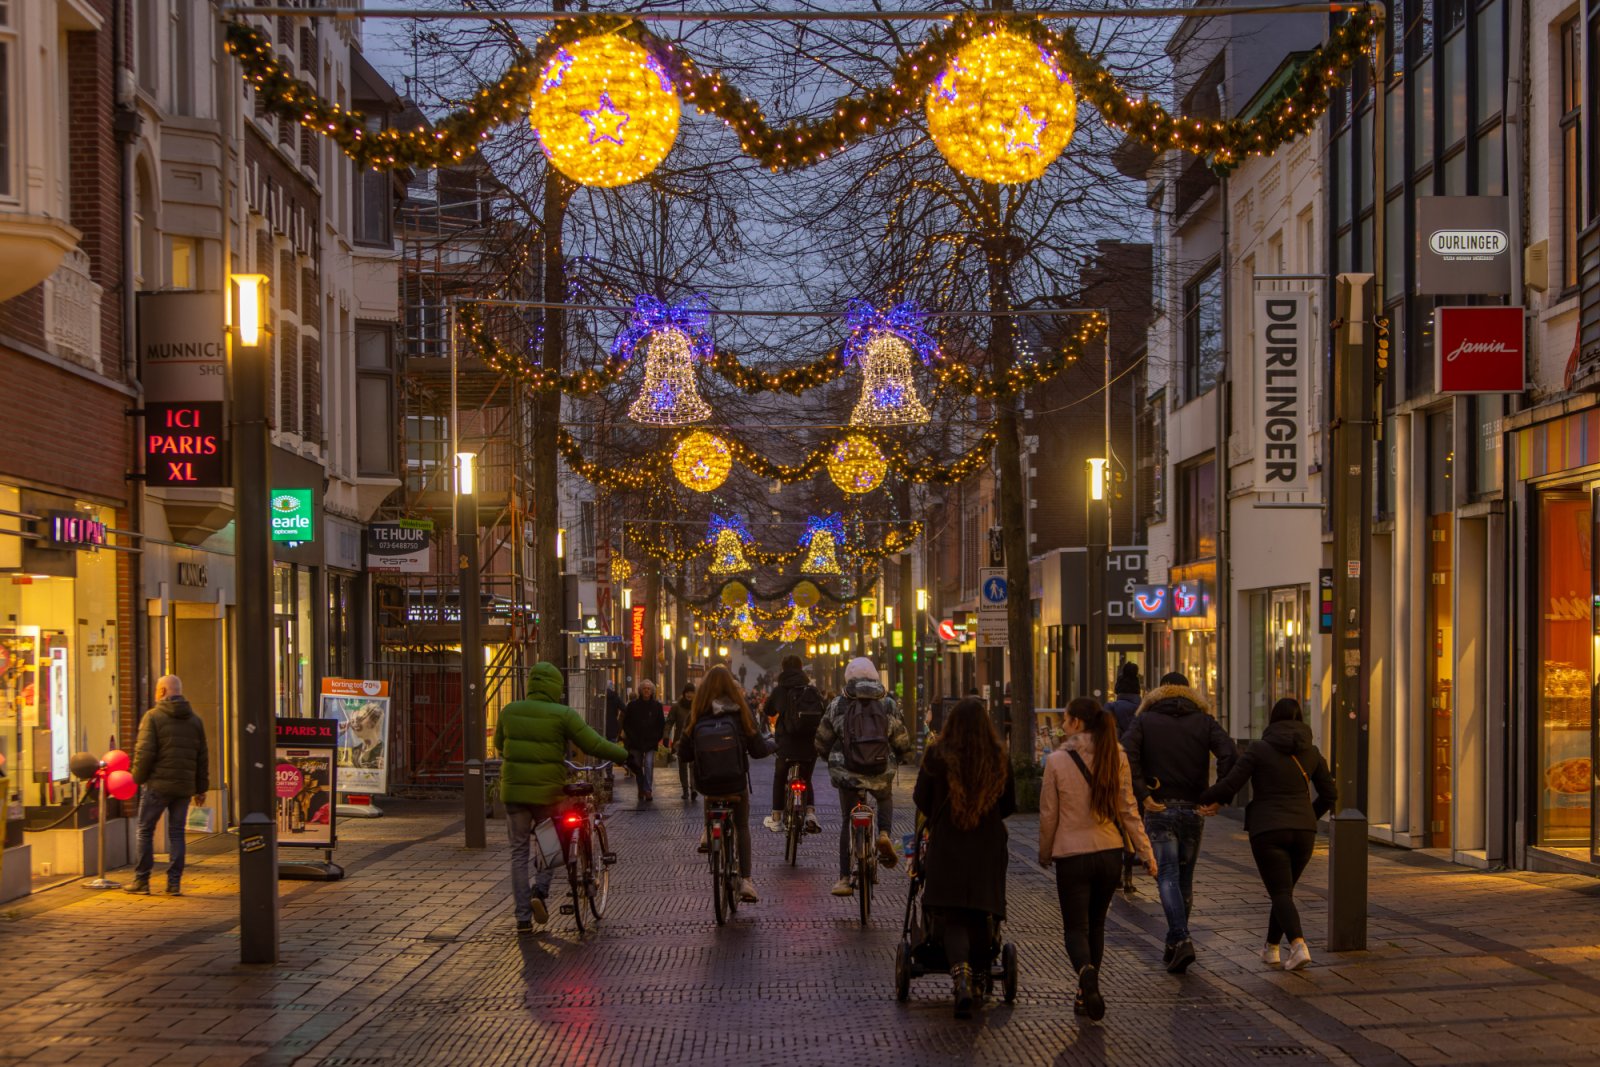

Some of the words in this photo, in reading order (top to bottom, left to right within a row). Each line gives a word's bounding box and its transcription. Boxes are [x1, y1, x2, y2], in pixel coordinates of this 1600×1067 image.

[1438, 235, 1499, 250] DURLINGER
[146, 342, 224, 359] MUNNICH
[1446, 337, 1518, 362] jamin
[199, 364, 224, 376] SHO
[1265, 299, 1297, 484] DURLINGER
[166, 409, 200, 428] ICI
[149, 435, 217, 455] PARIS
[167, 462, 198, 481] XL
[271, 514, 310, 528] earle
[373, 528, 388, 540] TE
[390, 528, 424, 541] HUUR
[331, 680, 353, 690] korting
[285, 725, 317, 736] PARIS
[319, 726, 332, 737] XL
